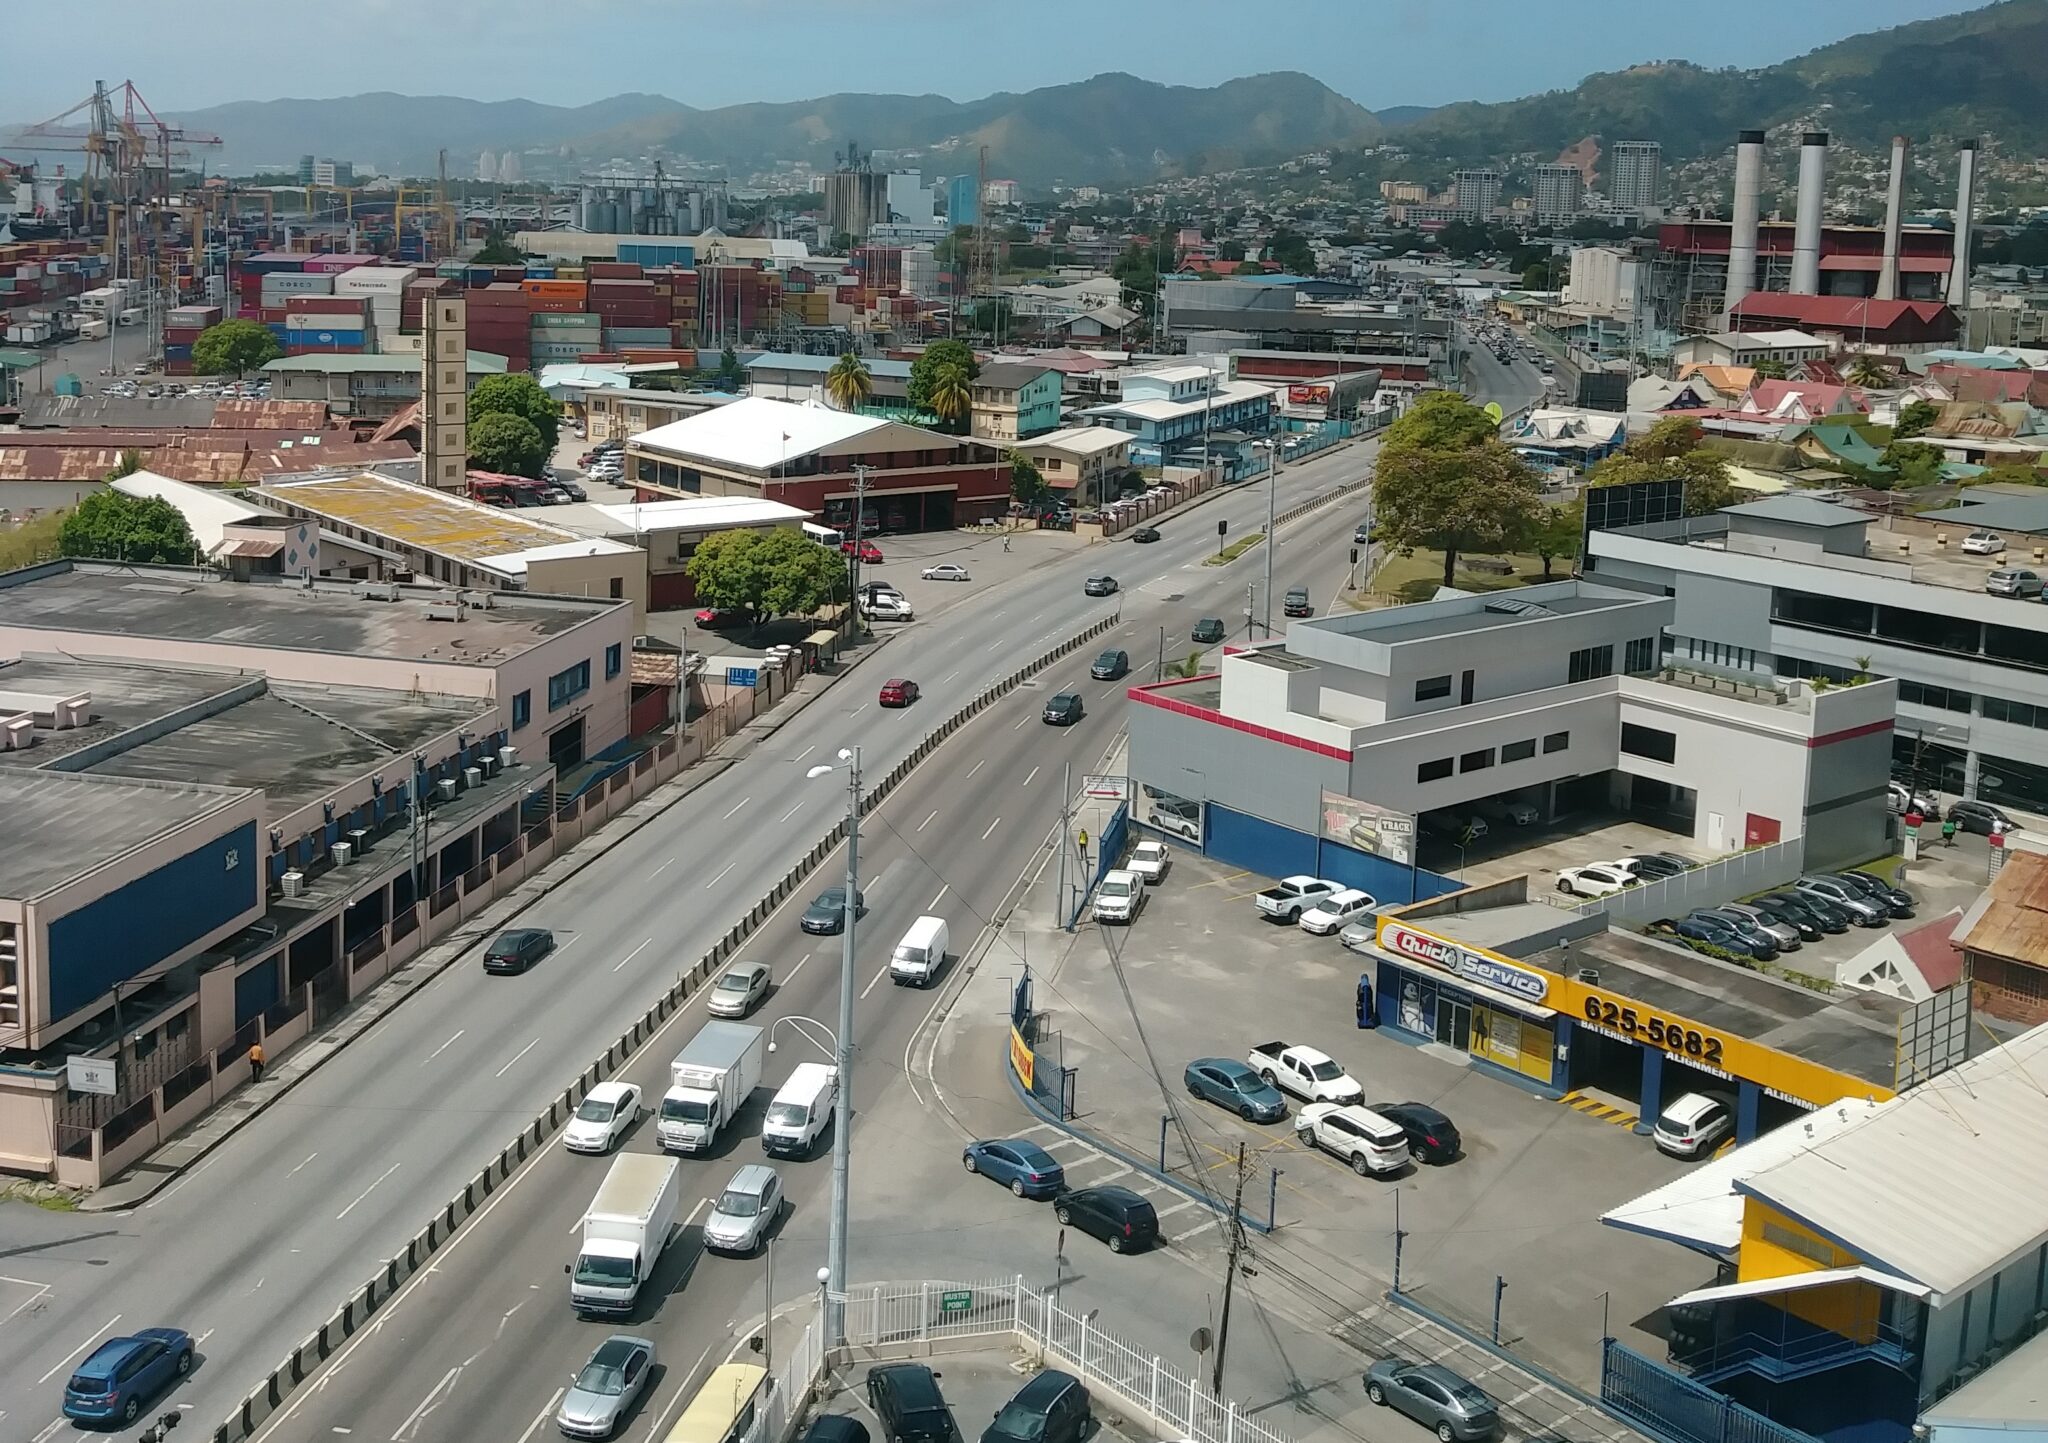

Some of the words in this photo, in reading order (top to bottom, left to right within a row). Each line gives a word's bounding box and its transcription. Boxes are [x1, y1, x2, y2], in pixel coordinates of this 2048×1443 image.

[323, 264, 345, 272] ONE
[1382, 821, 1410, 832] TRACK
[1401, 934, 1451, 966] Quick
[1464, 956, 1541, 994] Service
[1581, 1020, 1634, 1045] BATTERIES
[1585, 996, 1724, 1064] 625-5682
[1666, 1051, 1735, 1082] ALIGNMENT
[947, 1301, 966, 1309] POINT
